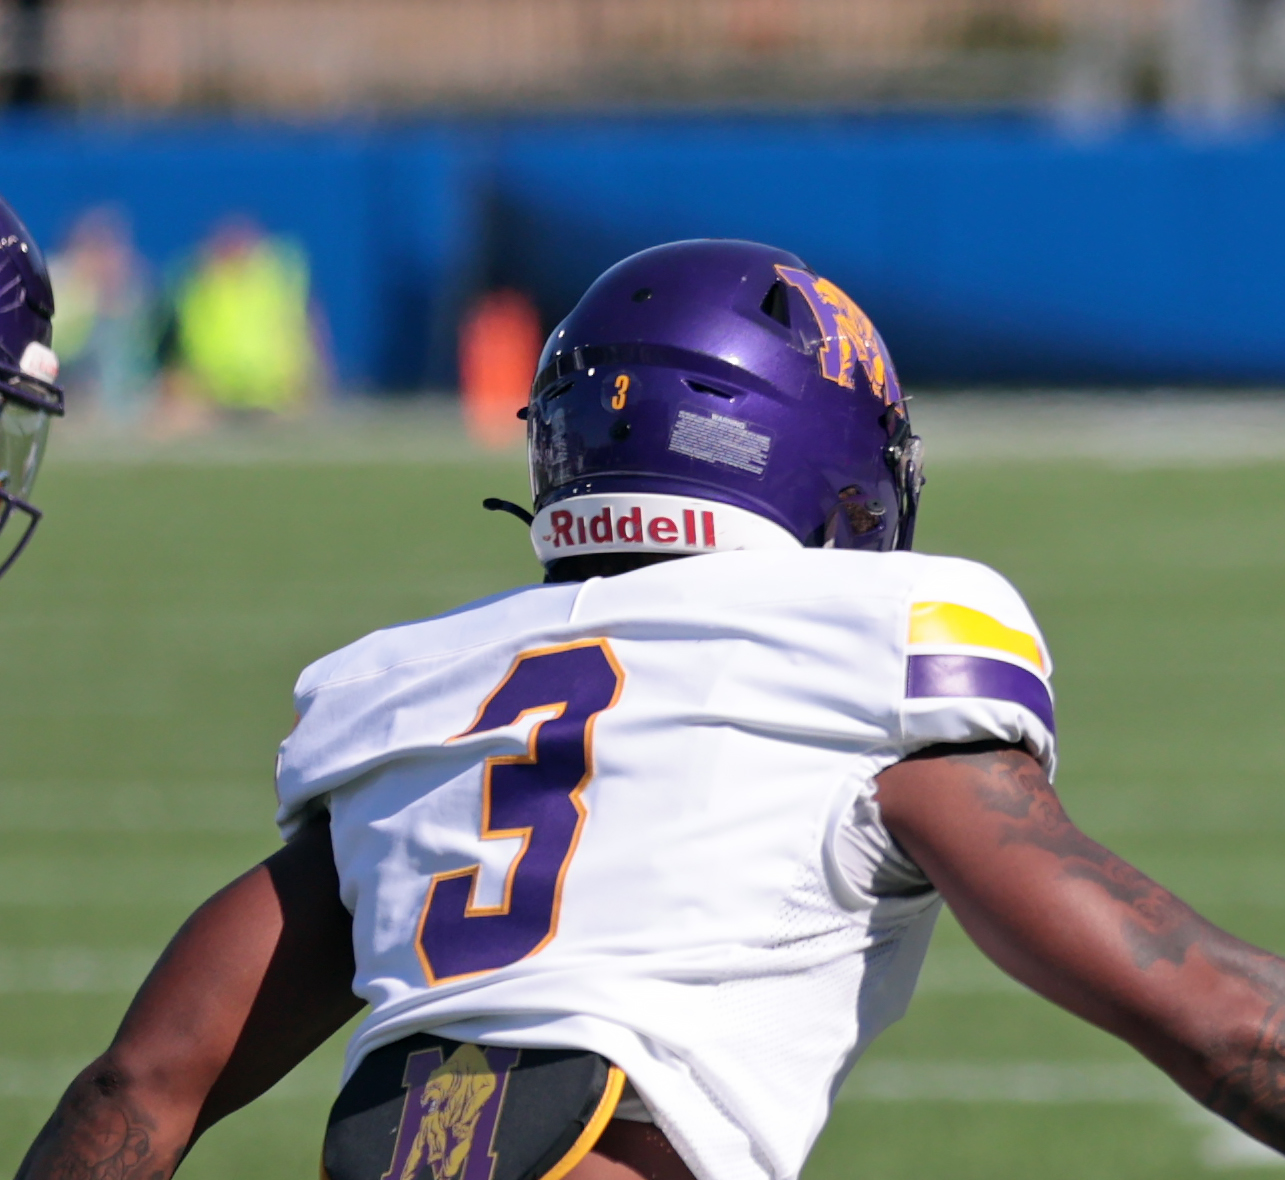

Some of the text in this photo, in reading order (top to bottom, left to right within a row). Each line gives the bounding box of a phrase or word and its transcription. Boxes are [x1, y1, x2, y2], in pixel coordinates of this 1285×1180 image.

[611, 374, 631, 410] 3
[543, 506, 716, 549] Riddell
[412, 636, 626, 988] 3
